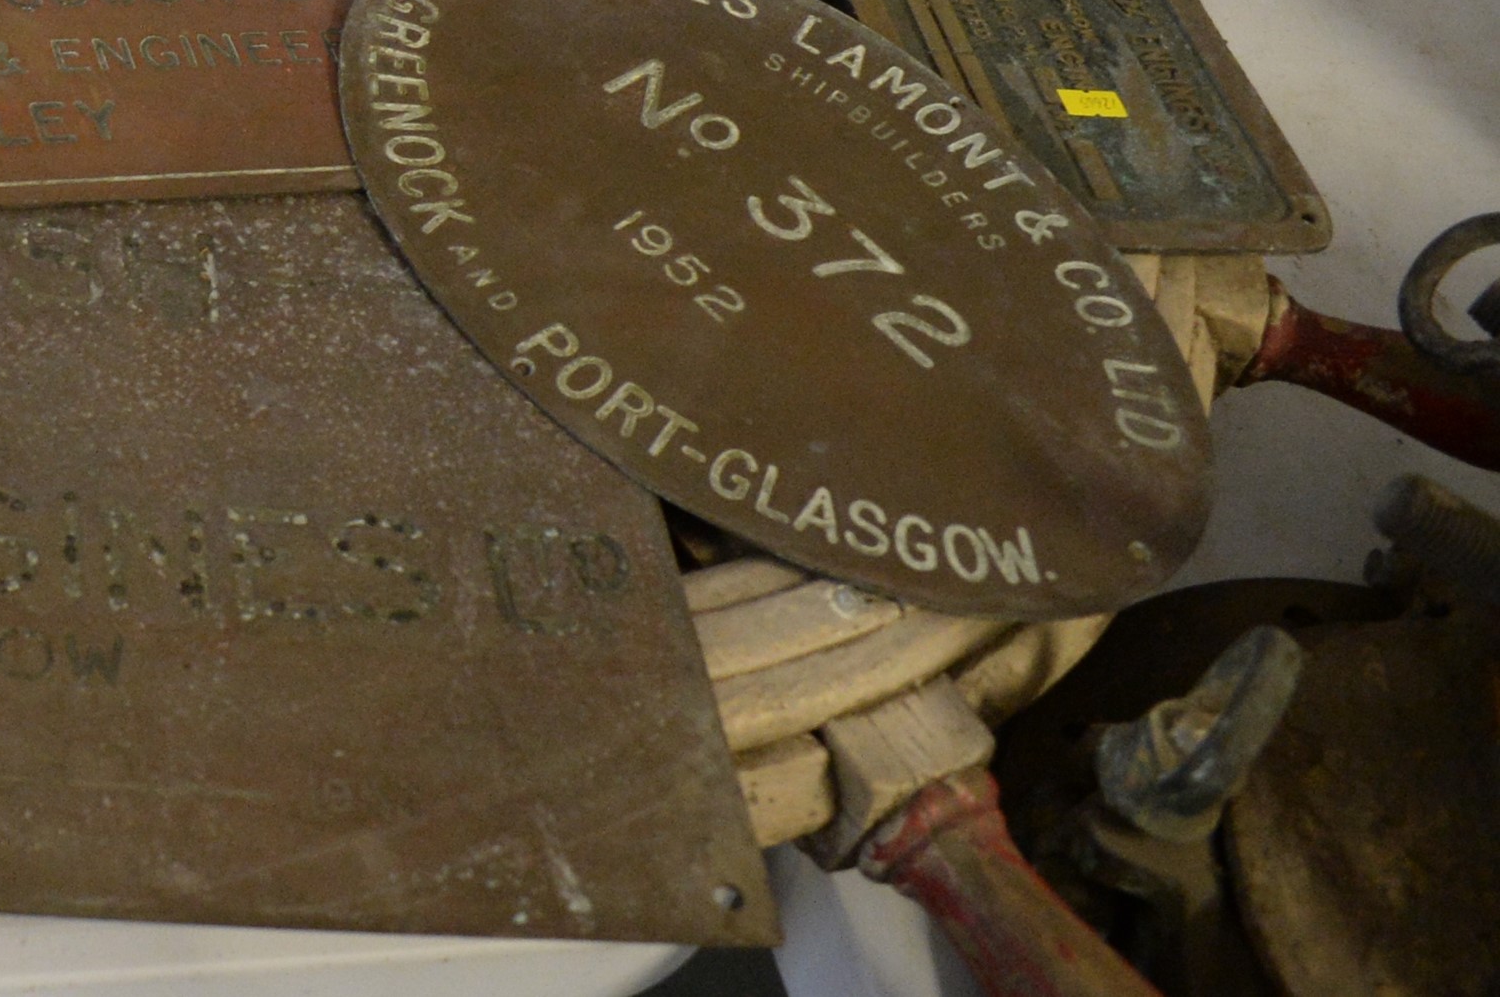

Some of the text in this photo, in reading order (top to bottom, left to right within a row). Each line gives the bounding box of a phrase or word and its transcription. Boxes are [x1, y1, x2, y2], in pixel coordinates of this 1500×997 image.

[790, 13, 1038, 195] LAMONT
[1015, 209, 1073, 245] &
[1039, 17, 1096, 92] ENGIN
[763, 51, 1007, 255] SHIPBUILDERS
[446, 242, 520, 316] AND
[612, 208, 748, 327] 1952
[746, 174, 973, 370] 372
